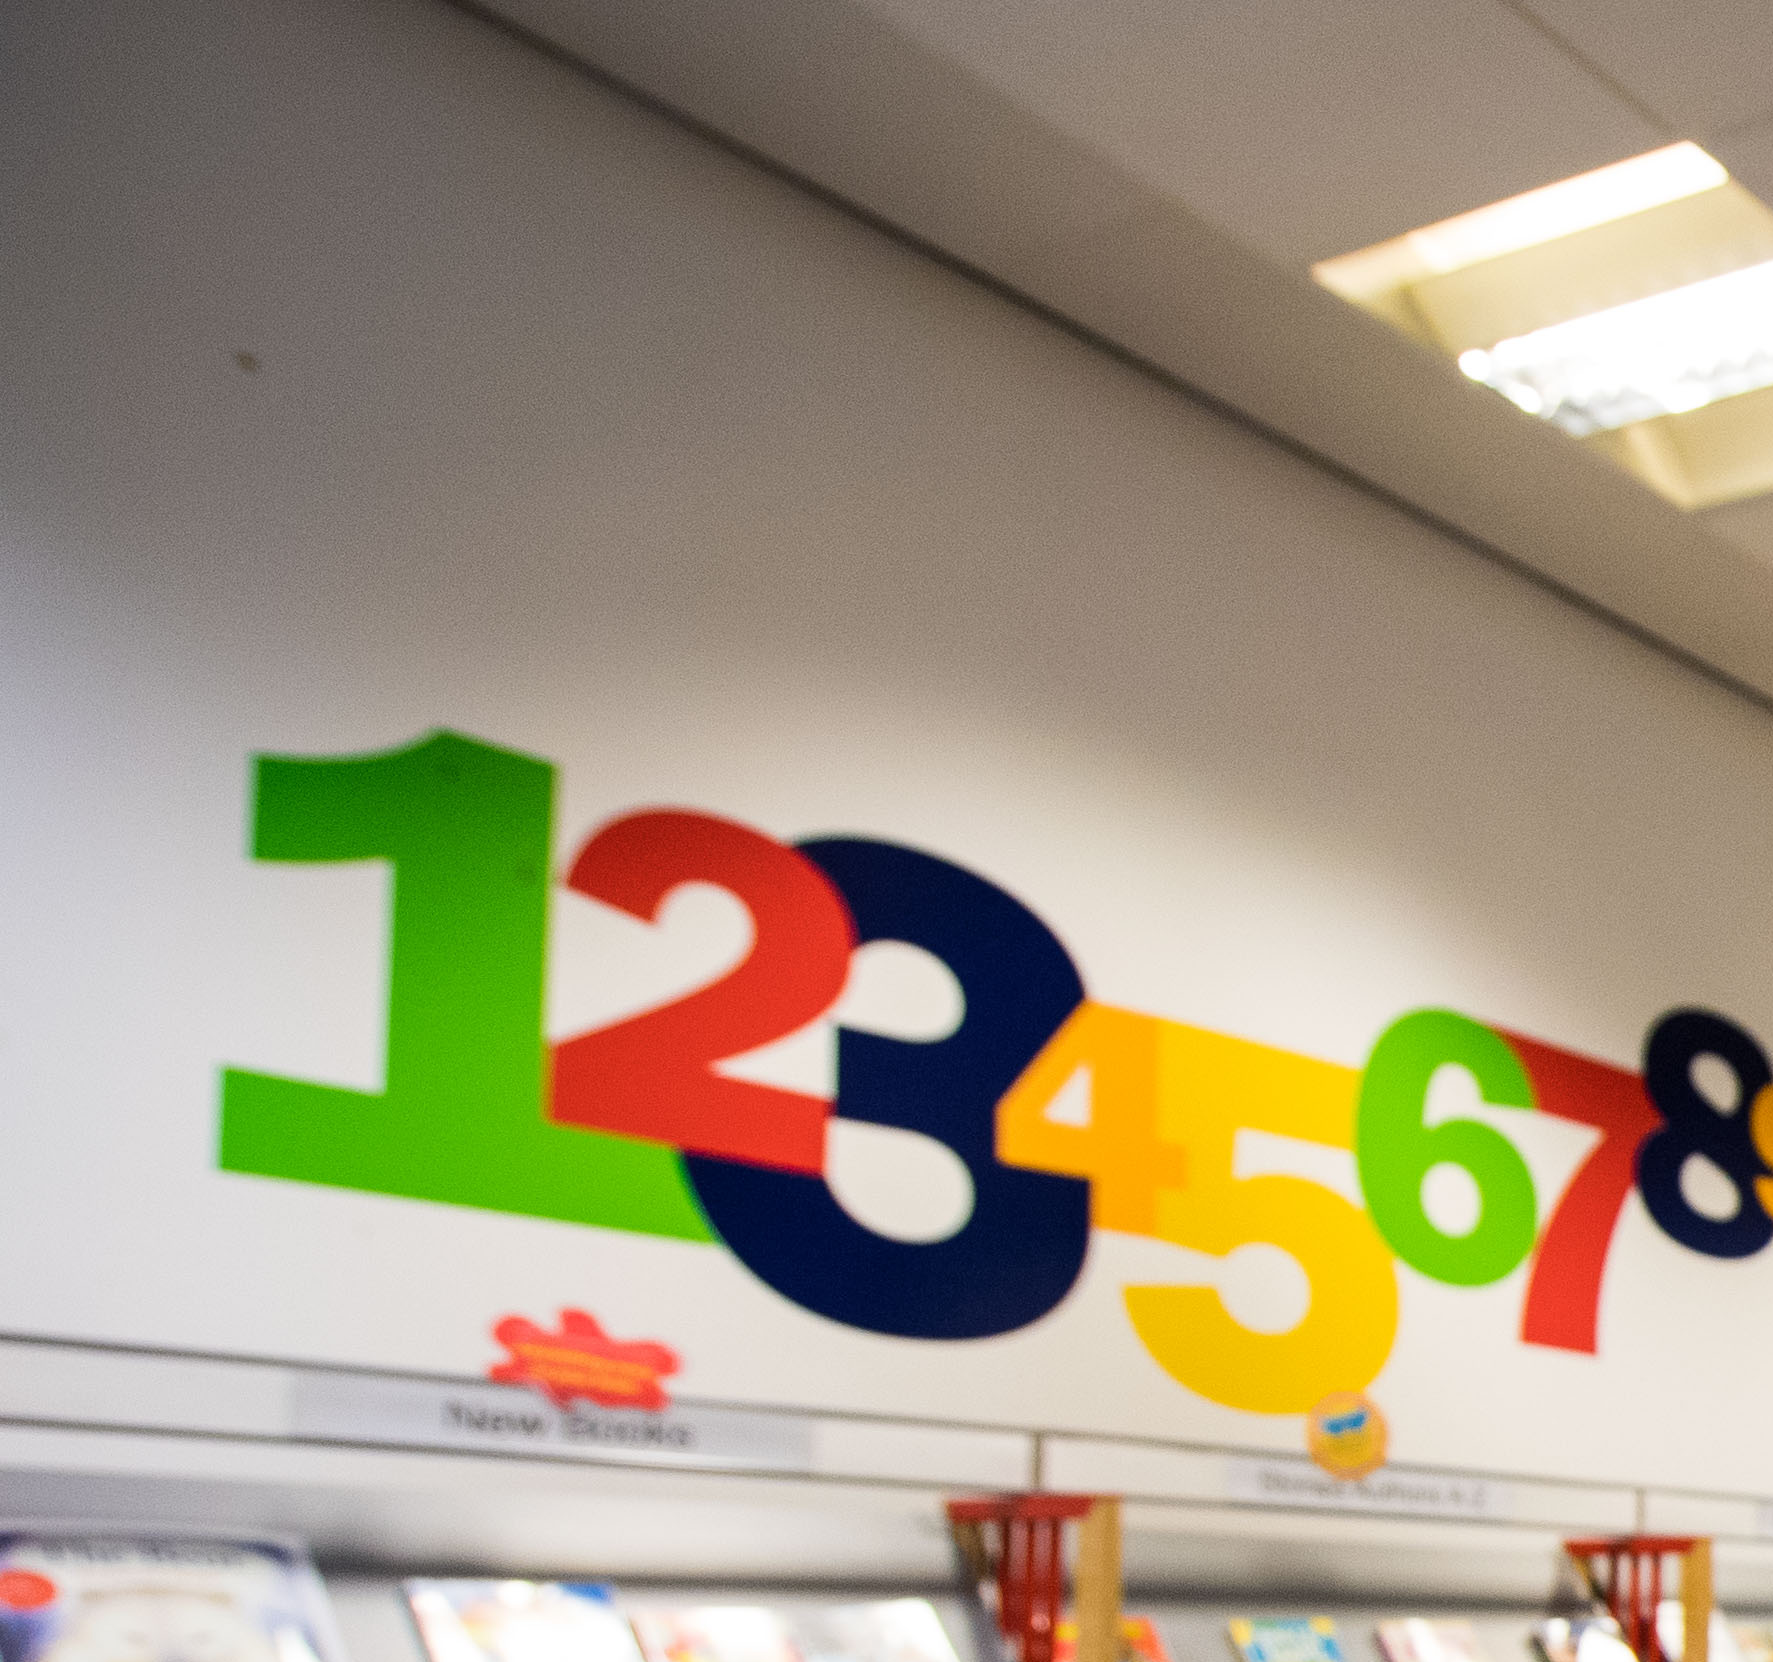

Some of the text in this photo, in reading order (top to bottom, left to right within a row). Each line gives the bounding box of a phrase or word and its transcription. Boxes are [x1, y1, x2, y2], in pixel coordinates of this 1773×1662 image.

[216, 728, 727, 1248] 1
[545, 806, 862, 1180] 2
[685, 832, 1088, 1342] 3
[995, 998, 1190, 1242] 4
[1355, 1007, 1538, 1288] 6
[1120, 1012, 1402, 1416] 5
[1485, 1023, 1668, 1356] 7
